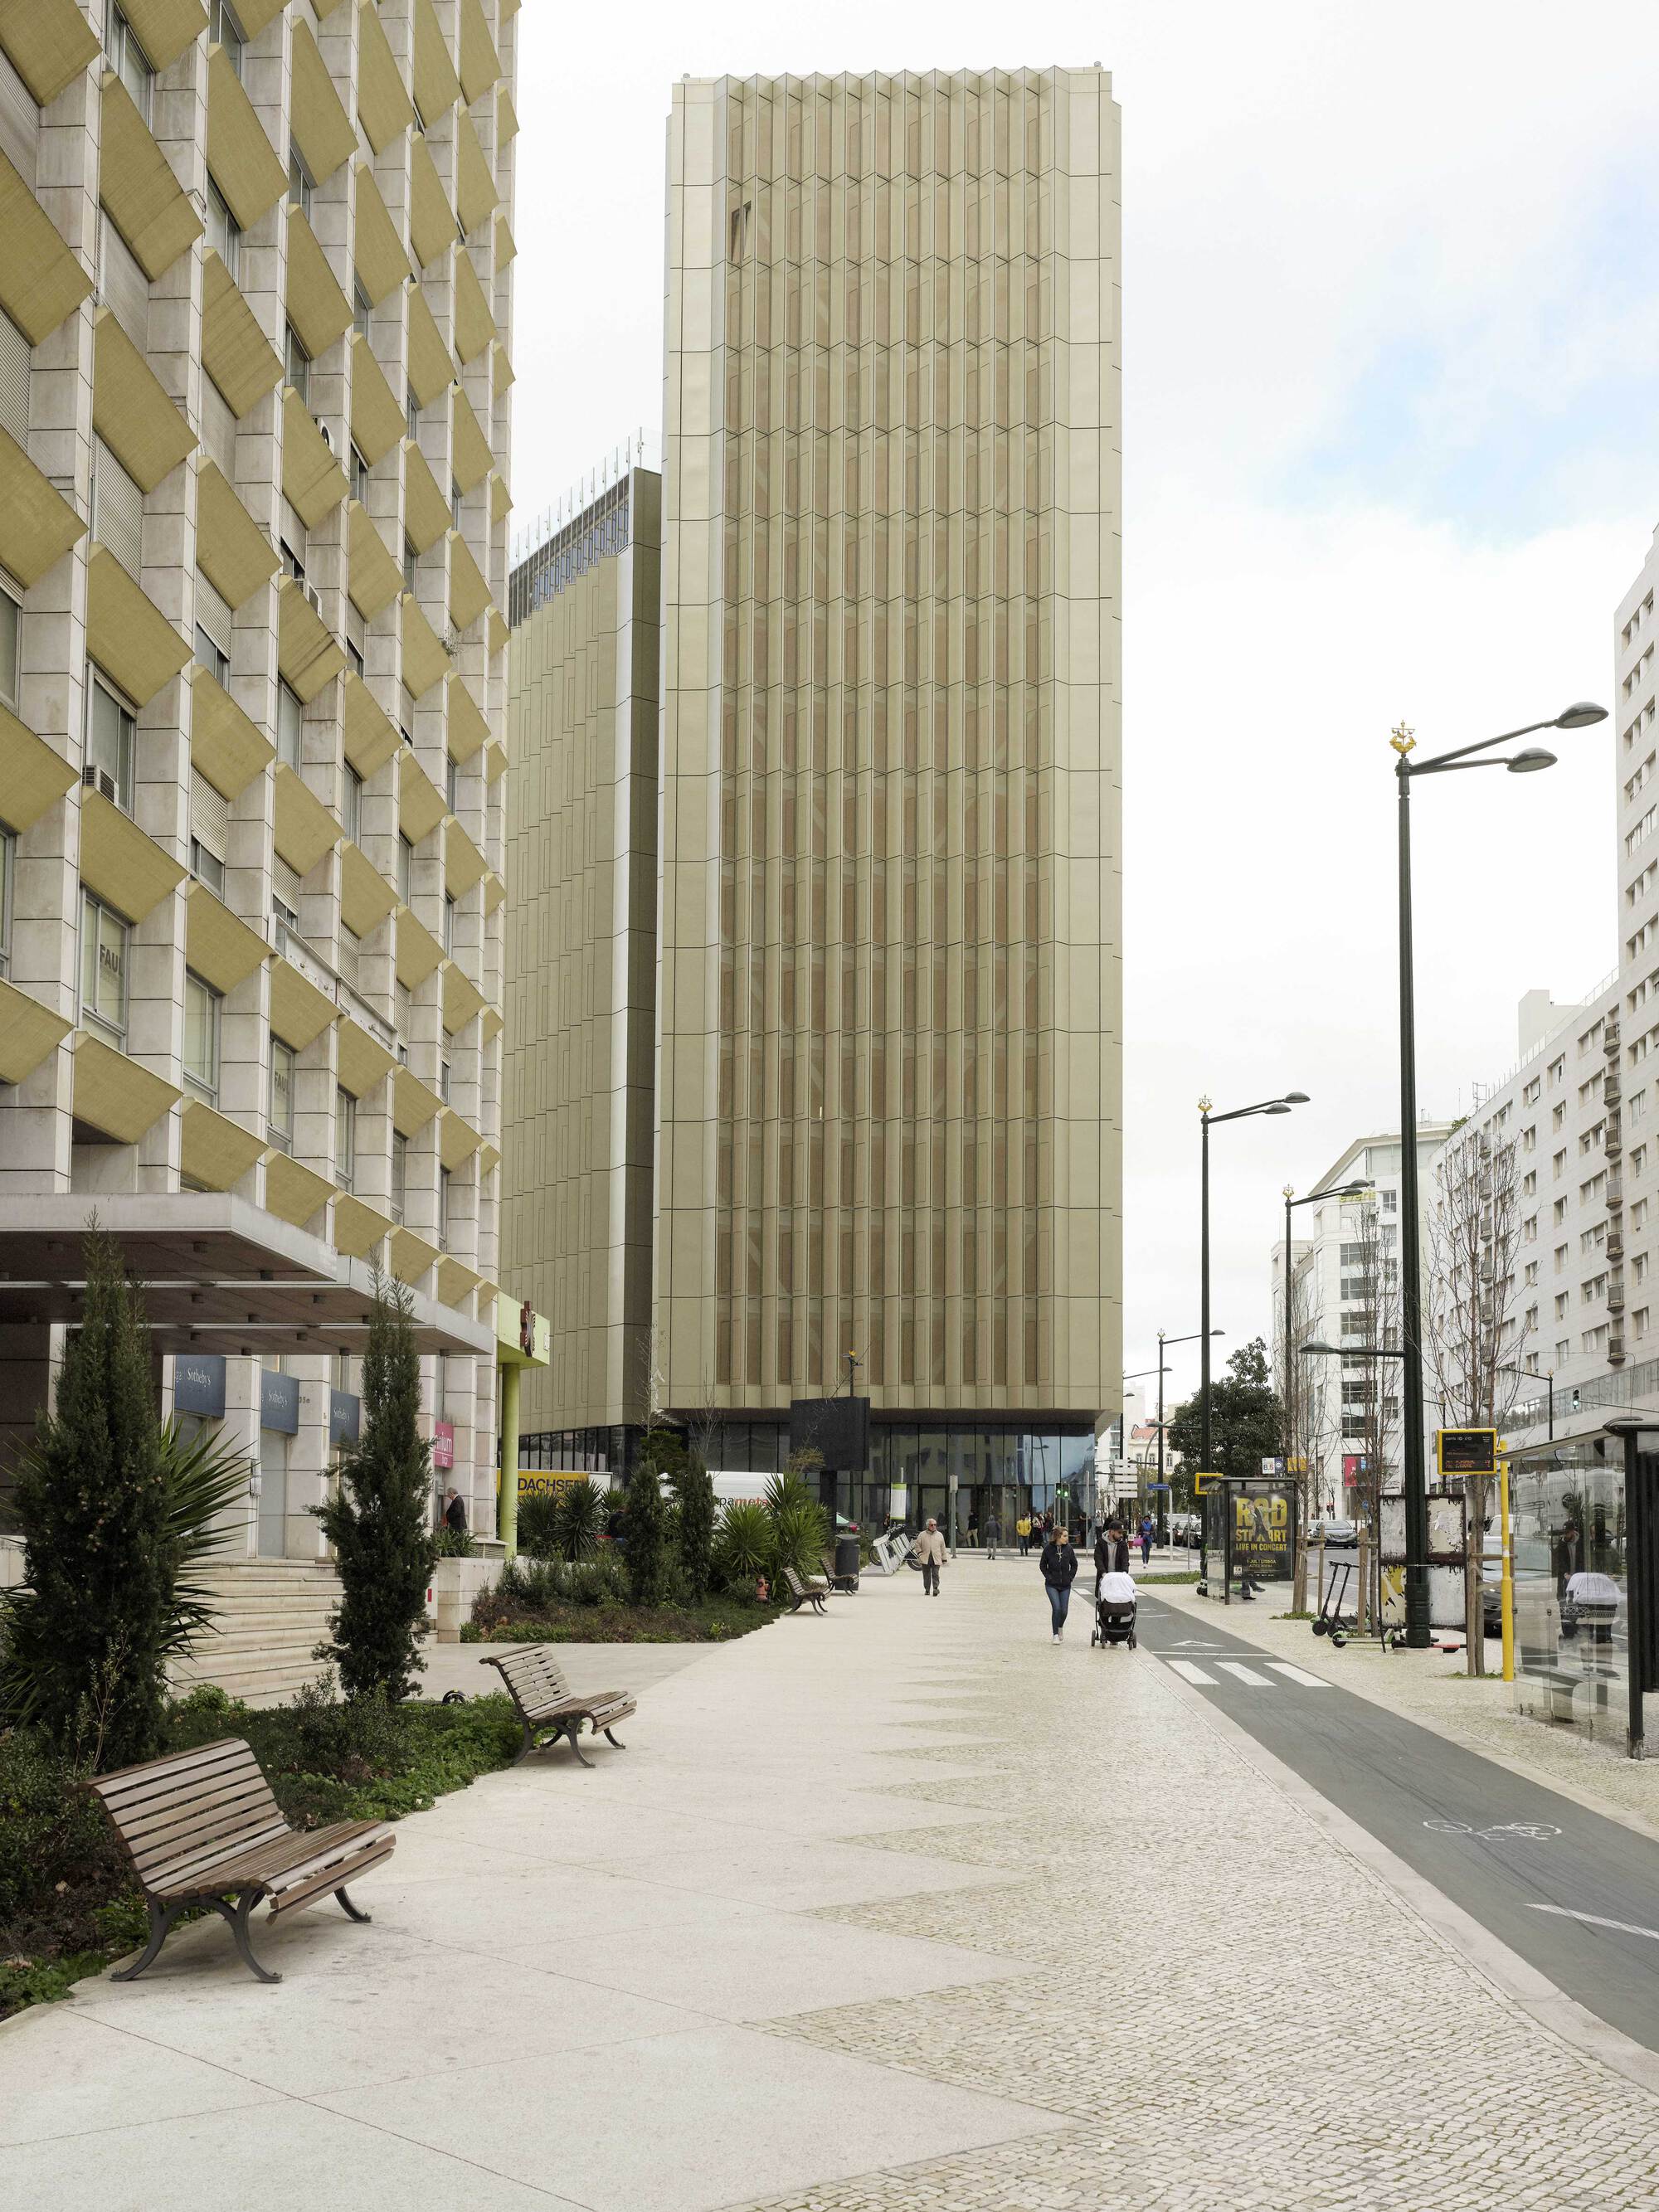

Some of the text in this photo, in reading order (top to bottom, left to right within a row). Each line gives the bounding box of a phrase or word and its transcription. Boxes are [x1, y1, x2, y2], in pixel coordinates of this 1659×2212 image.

[187, 1367, 211, 1388] Sotheby's
[1236, 1498, 1287, 1527] ROD
[1236, 1529, 1287, 1542] STEART
[1259, 1544, 1287, 1552] CONCERT
